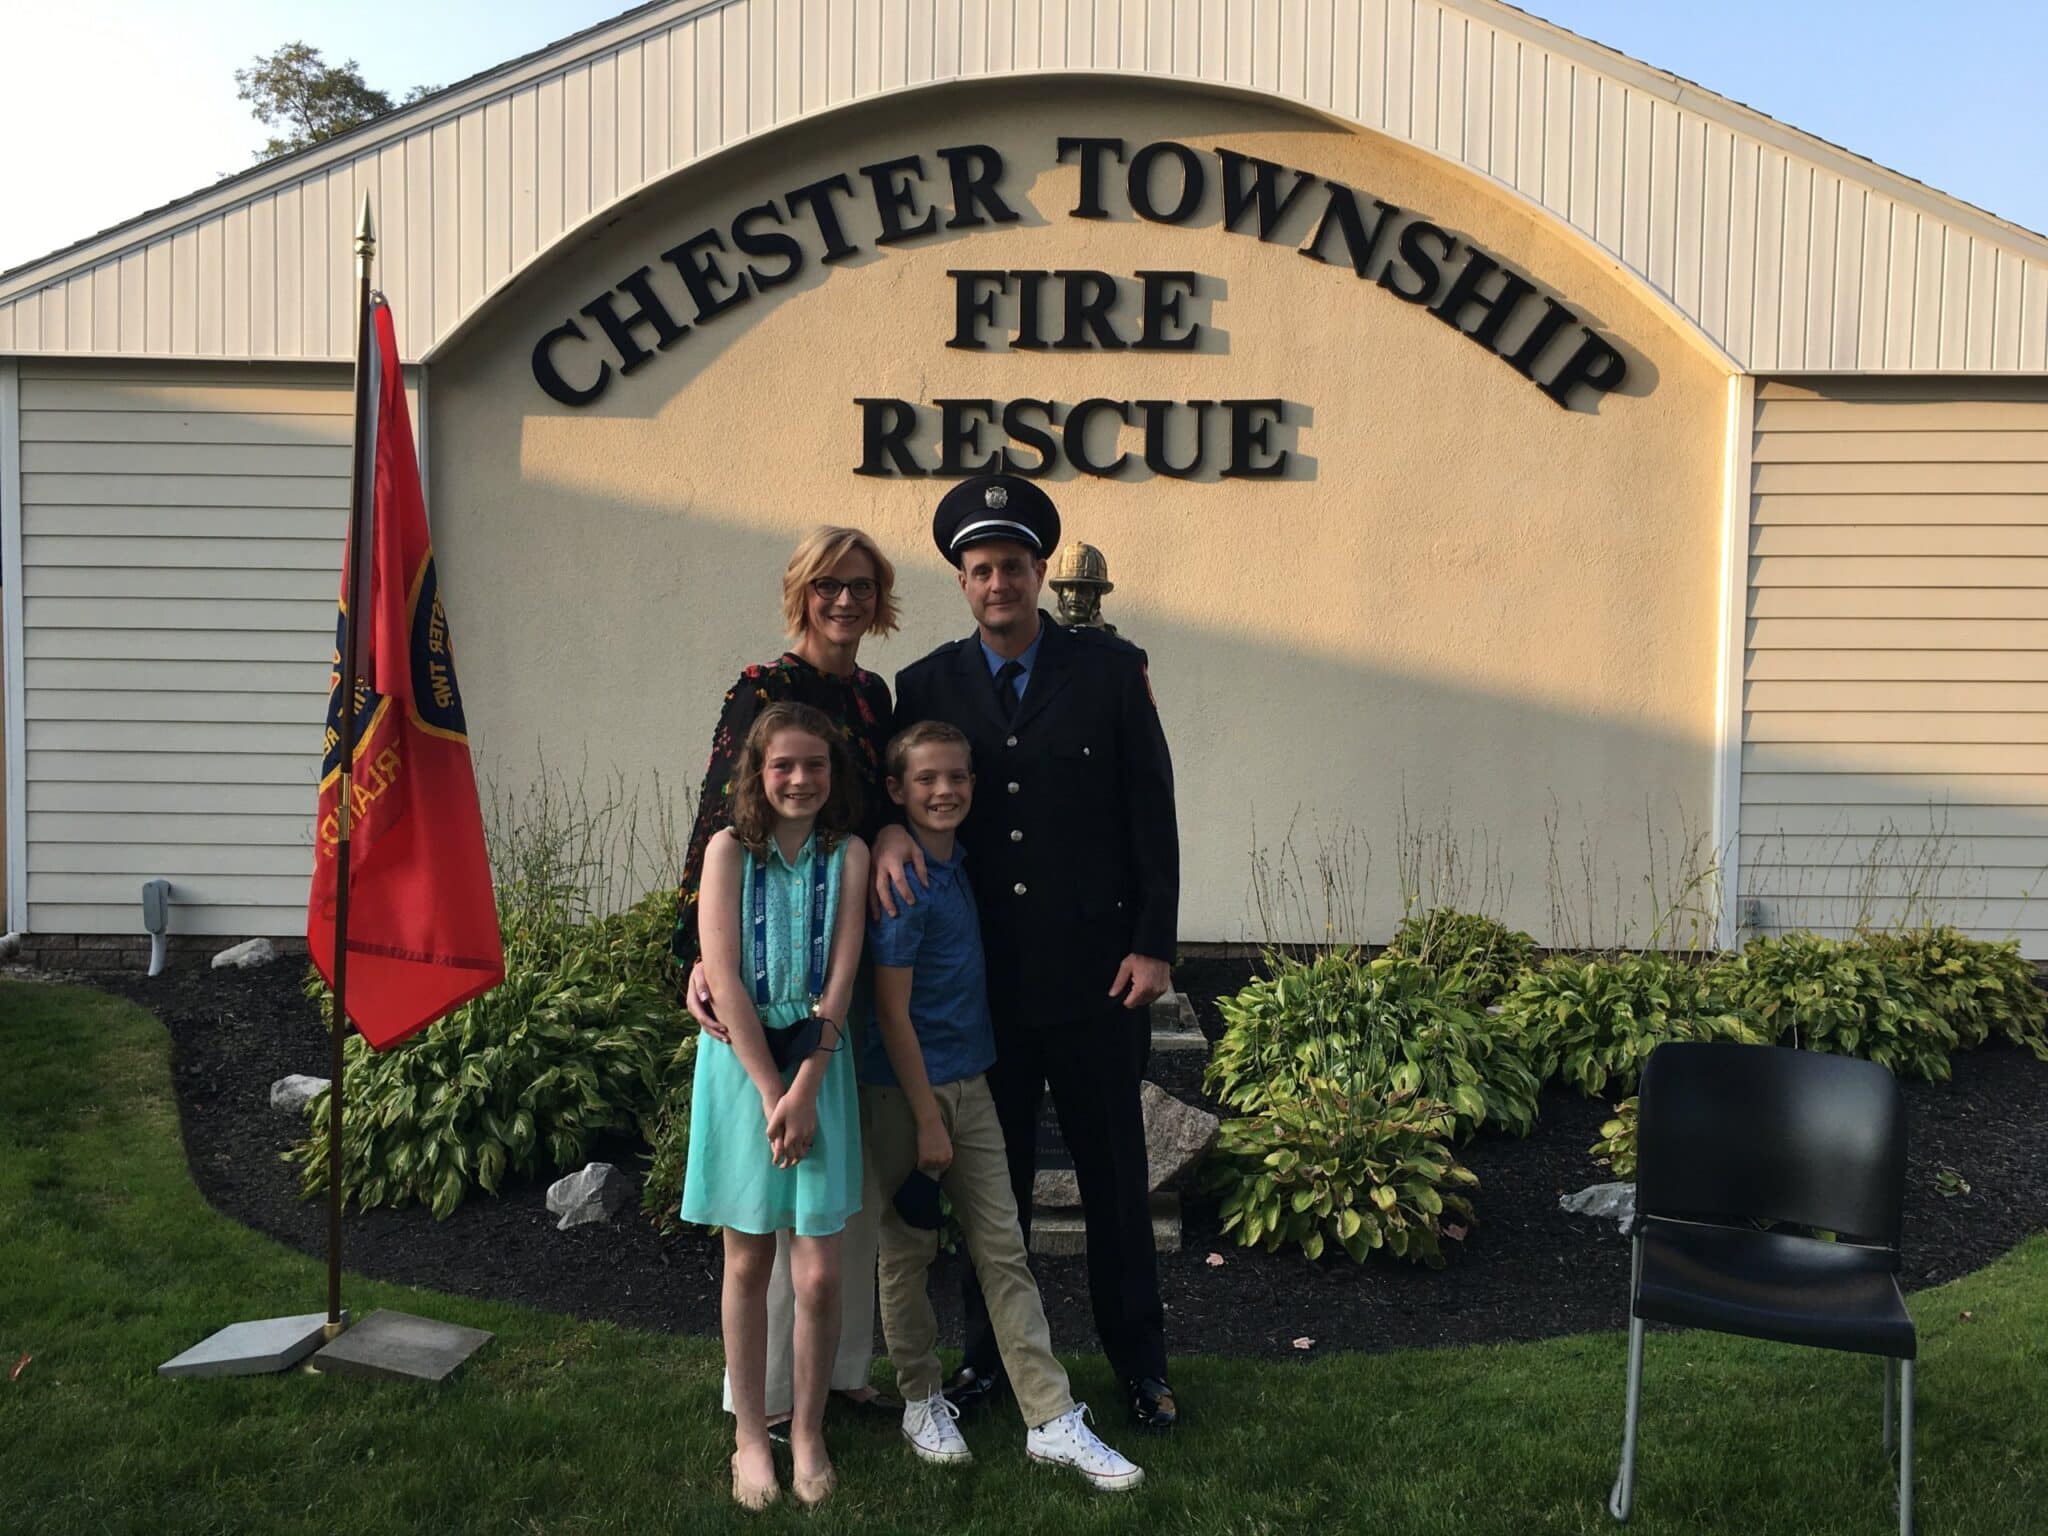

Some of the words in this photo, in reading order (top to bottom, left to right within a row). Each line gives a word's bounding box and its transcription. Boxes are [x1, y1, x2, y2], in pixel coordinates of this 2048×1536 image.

[531, 144, 1020, 408] CHESTER
[1057, 137, 1627, 411] TOWNSHIP
[945, 269, 1200, 350] FIRE
[852, 397, 1288, 479] RESCUE
